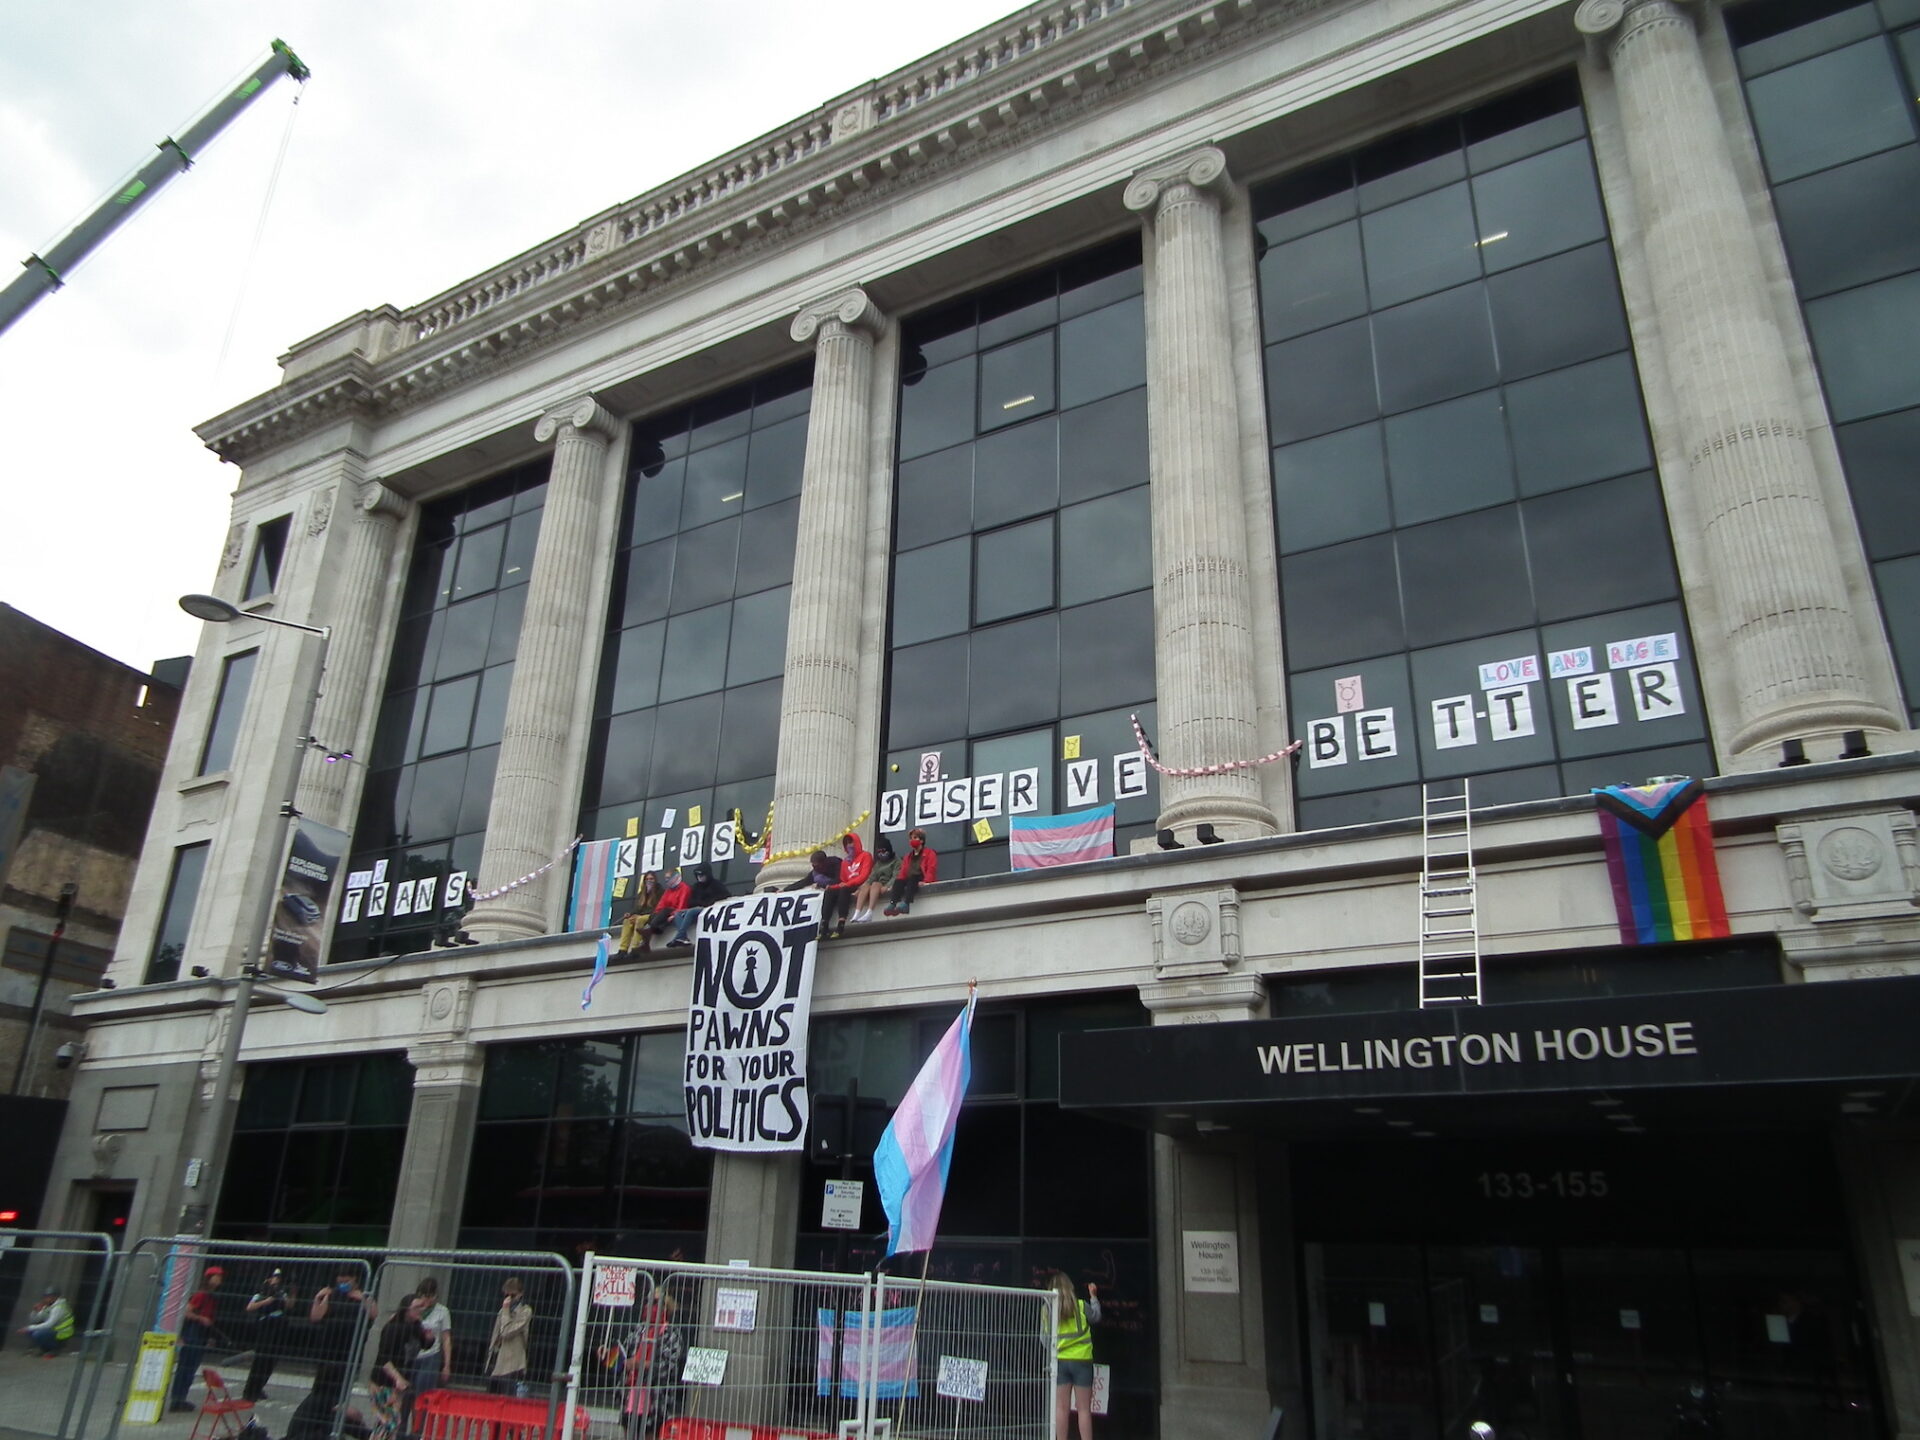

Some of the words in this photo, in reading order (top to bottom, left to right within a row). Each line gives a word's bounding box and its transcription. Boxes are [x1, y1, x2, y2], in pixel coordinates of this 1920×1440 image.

[1484, 657, 1536, 683] LOVE
[1551, 651, 1590, 674] AND
[1611, 639, 1669, 664] RAGE
[883, 756, 1144, 828] DESERVE
[288, 864, 329, 882] REINVENTED
[290, 855, 327, 873] EXPLORING
[347, 875, 463, 918] TRANS
[702, 902, 745, 933] WE
[747, 893, 820, 927] ARE
[692, 922, 819, 1010] NOT
[690, 1004, 795, 1051] PAWNS
[1256, 1033, 1521, 1075] WELLINGTON
[1534, 1022, 1698, 1062] HOUSE
[685, 1054, 727, 1083] FOR
[738, 1050, 796, 1084] YOUR
[685, 1077, 805, 1143] POLITICS
[1478, 1171, 1609, 1198] 133-155
[1190, 1240, 1231, 1251] Wellington
[1198, 1250, 1224, 1260] House
[602, 1280, 629, 1295] KILL
[605, 1271, 626, 1281] LISTS
[938, 1381, 986, 1399] PRESCRIPTIONS
